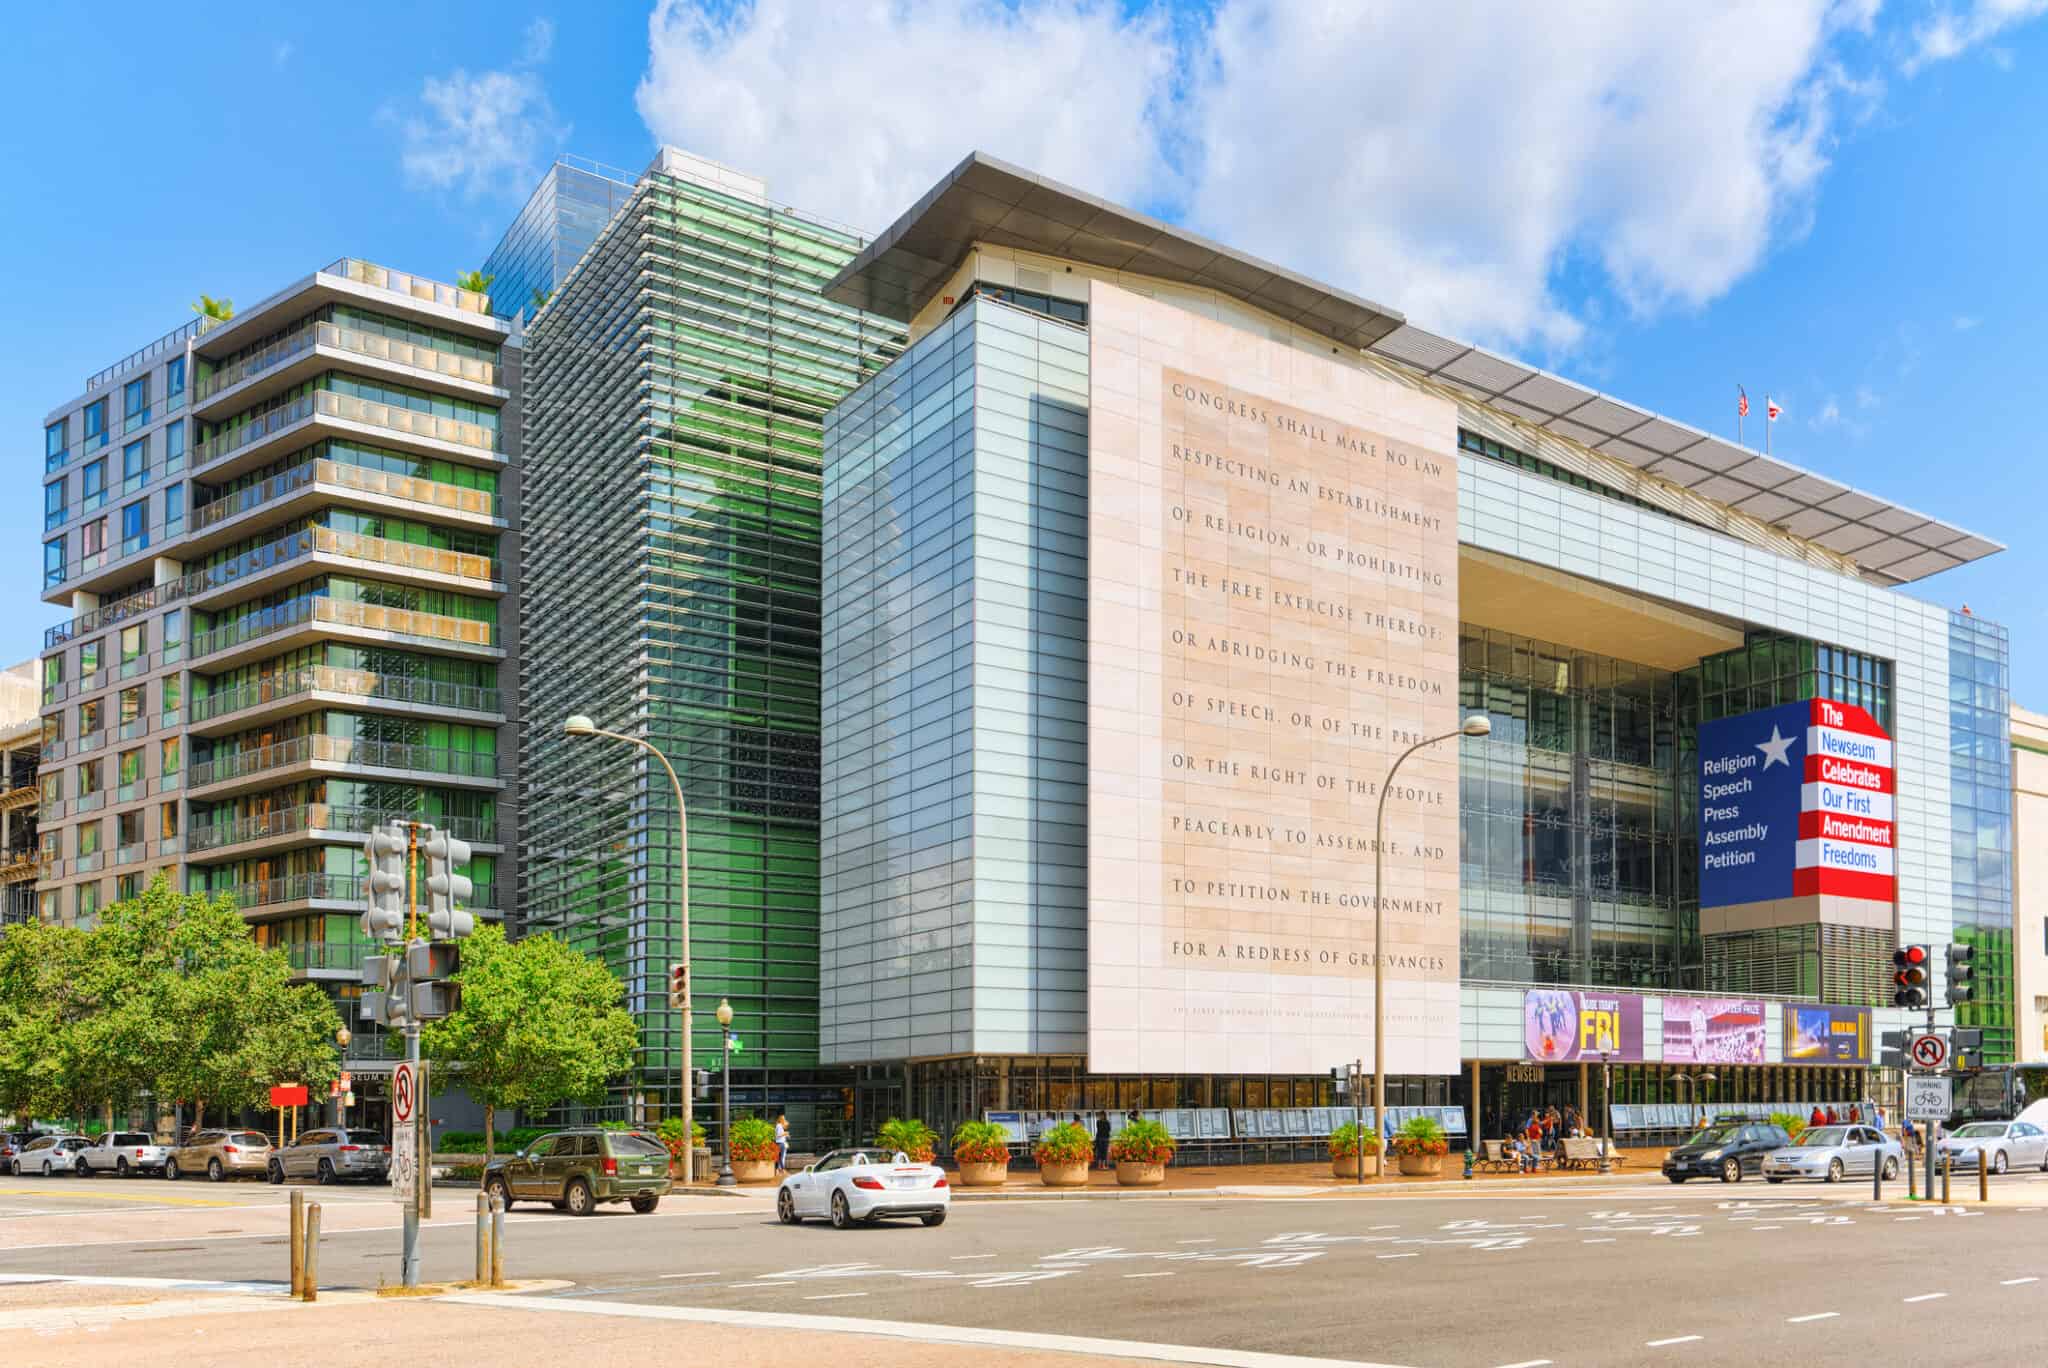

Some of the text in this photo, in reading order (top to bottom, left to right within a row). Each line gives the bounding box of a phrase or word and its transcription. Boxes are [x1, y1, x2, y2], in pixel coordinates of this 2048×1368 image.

[1173, 383, 1441, 476] CONGRESS SHALL MAKE NO LAW
[1173, 444, 1441, 531] RESPECTING AN ESTABLISHMENT
[1173, 506, 1192, 523] OF
[1307, 542, 1327, 558] OR
[1338, 548, 1442, 586] PROHIBITING
[1172, 567, 1208, 588] THE
[1222, 579, 1263, 600] FREE
[1275, 591, 1353, 621] EXERCISE
[1173, 630, 1441, 695] OR ABRIDGING THE FREEDOM
[1173, 692, 1194, 708] OF
[1291, 713, 1313, 729] OR
[1322, 718, 1341, 733] OF
[1350, 722, 1382, 740] THE
[1821, 703, 1844, 727] The
[1822, 731, 1876, 760] Newseum
[1173, 753, 1443, 805] OR THE RIGHT OF THE PEOPLE
[1703, 754, 1756, 776] Religion
[1822, 759, 1881, 789] Celebrates
[1703, 777, 1752, 800] Speech
[1822, 787, 1871, 814] Our First
[1704, 806, 1739, 823] Press
[1173, 816, 1275, 842] PEACEABLY
[1284, 829, 1307, 844] TO
[1414, 845, 1444, 860] AND
[1704, 822, 1768, 847] Assembly
[1823, 815, 1891, 844] Amendment
[1704, 850, 1755, 870] Petition
[1823, 843, 1877, 869] Freedoms
[1172, 879, 1196, 894] TO
[1207, 881, 1290, 902] PETITION
[1299, 890, 1330, 905] THE
[1173, 941, 1208, 957] FOR
[1216, 945, 1228, 958] A
[1237, 944, 1310, 963] REDRESS
[1319, 950, 1340, 965] OF
